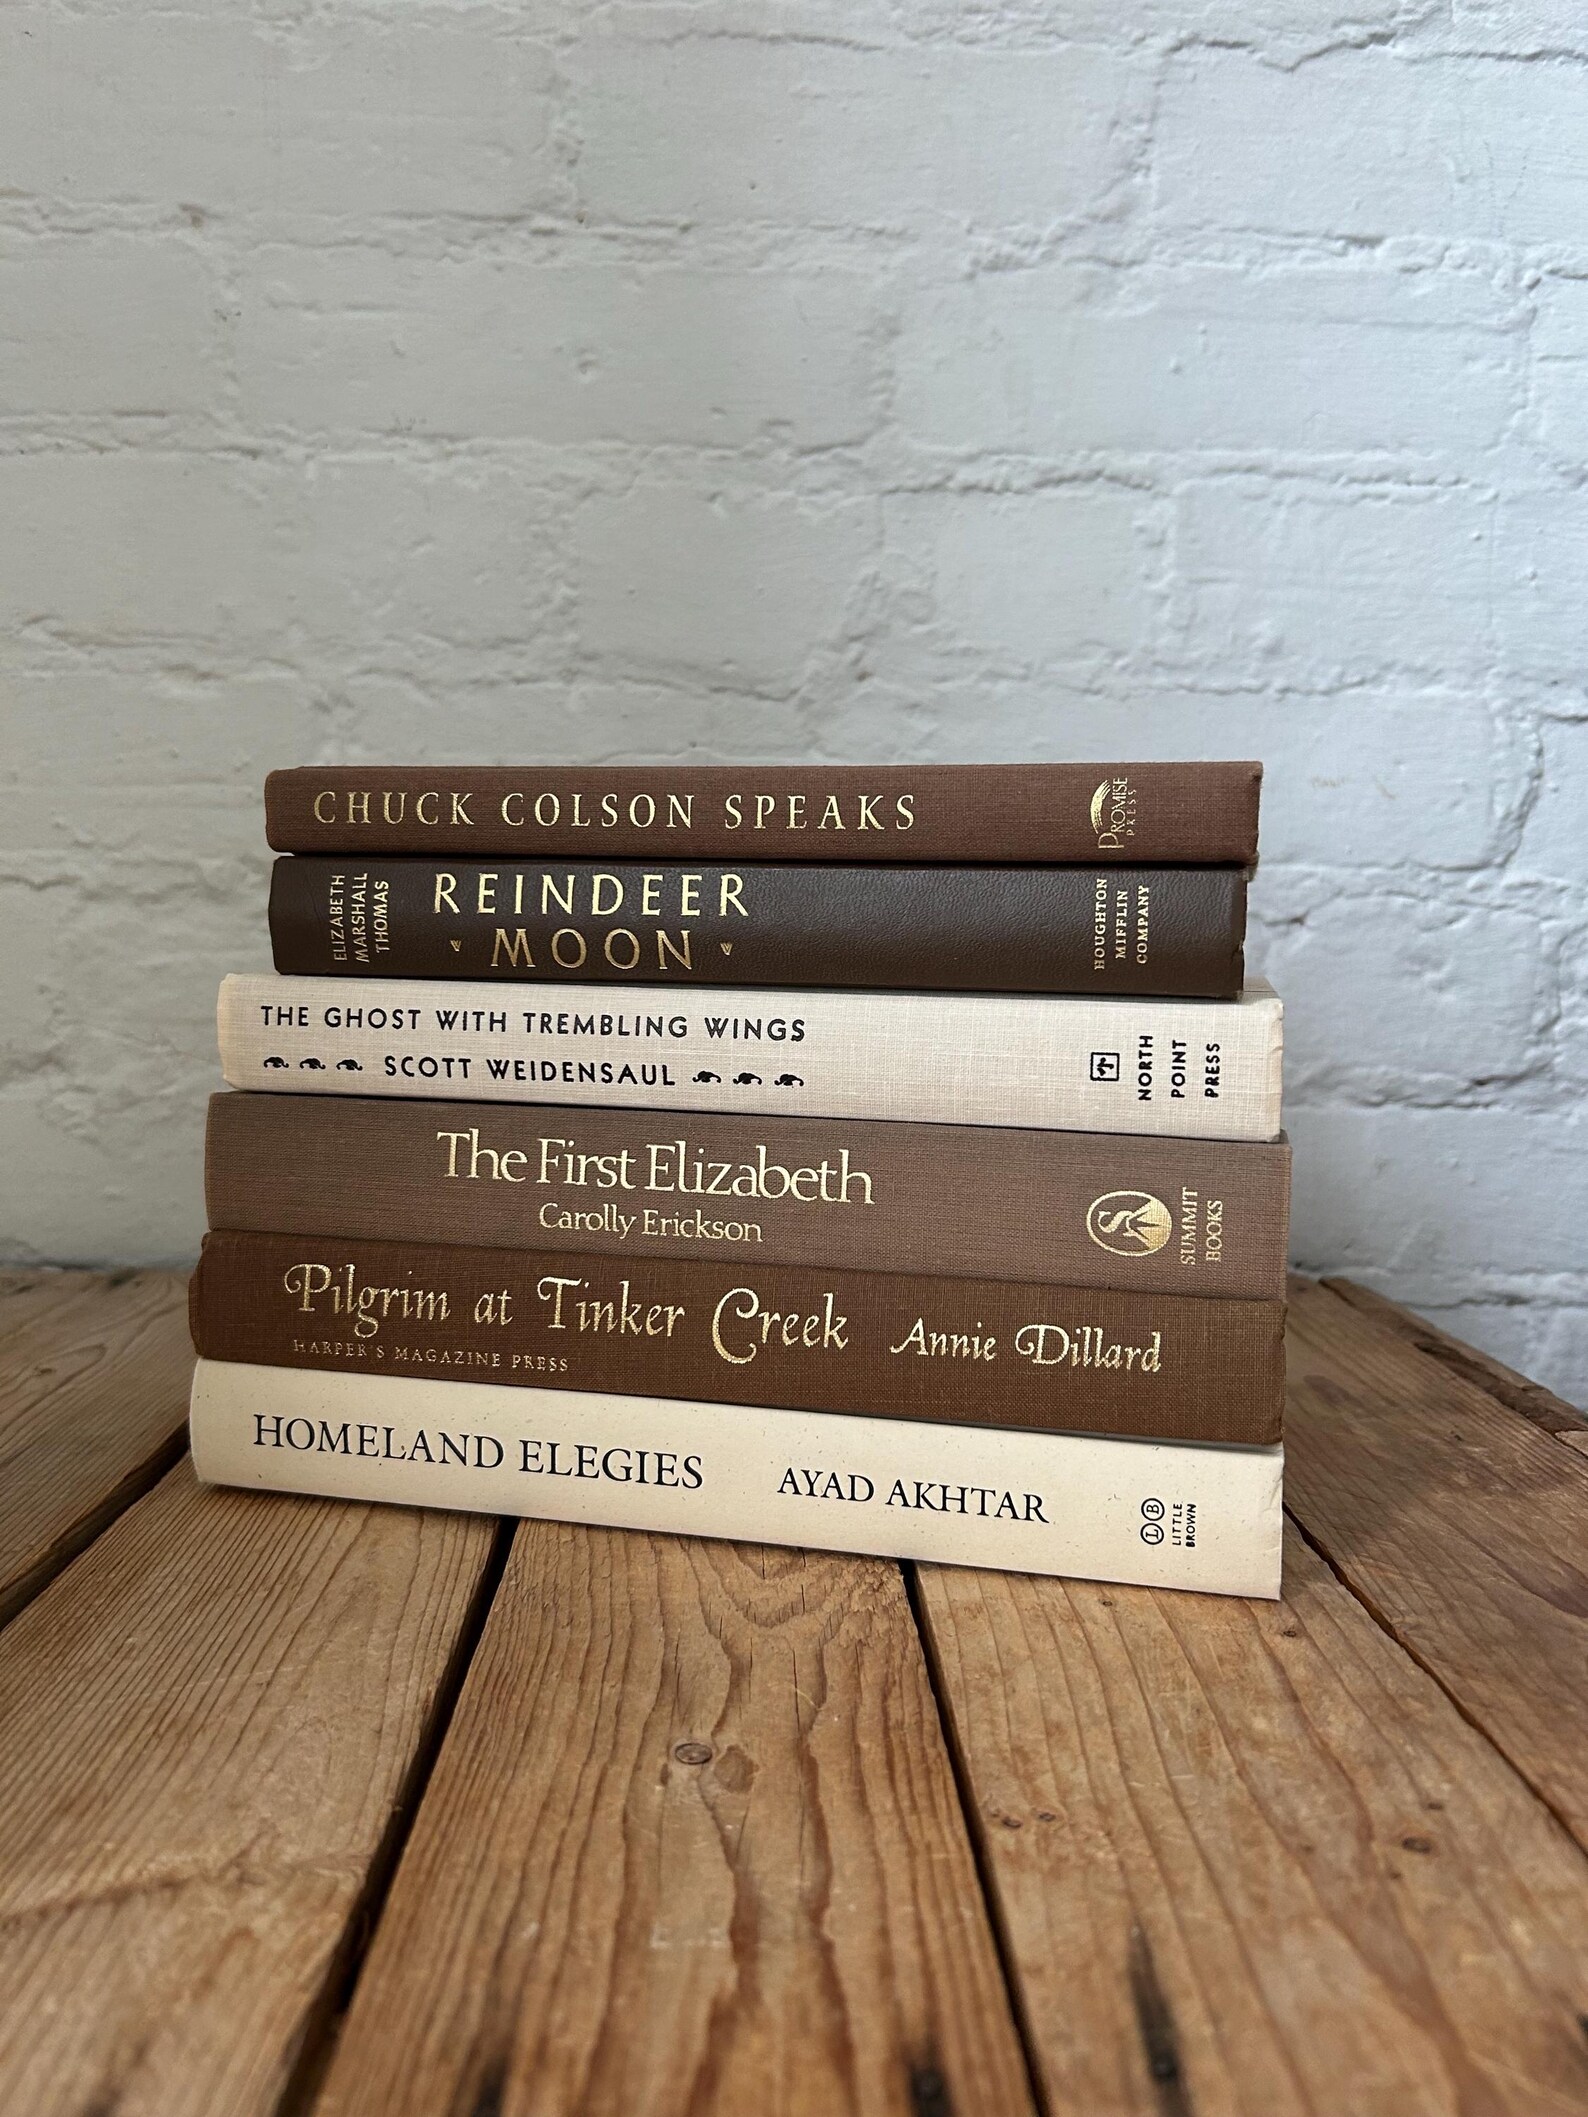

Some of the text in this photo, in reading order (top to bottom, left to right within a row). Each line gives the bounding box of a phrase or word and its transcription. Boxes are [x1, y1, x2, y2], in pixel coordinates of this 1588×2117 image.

[314, 791, 916, 830] CHUCK COLSON SPEAKS
[1126, 788, 1137, 837] PRESS
[330, 874, 348, 962] ELIZABETH
[351, 872, 368, 963] MARSHALL
[375, 880, 390, 953] THOMAS
[432, 873, 749, 917] REINDEER
[1094, 878, 1107, 970] HOUGHTON
[489, 928, 694, 970] MOON
[1116, 890, 1128, 959] MIFFLIN
[1137, 885, 1151, 965] COMPANY
[260, 1005, 806, 1043] THE GHOST WITH TREMBLING WINGS
[384, 1056, 676, 1086] SCOTT WEIDENSAUL
[1138, 1035, 1153, 1101] NORTH
[1171, 1039, 1187, 1099] POINT
[1205, 1042, 1220, 1099] PRESS
[436, 1128, 876, 1206] The First Elizabeth
[538, 1203, 764, 1244] Carolly Erickson
[1181, 1187, 1199, 1265] SUMMIT
[1205, 1200, 1224, 1263] BOOKS
[283, 1263, 849, 1364] Pilgrim at Tinker Creek
[395, 1347, 501, 1368] MAGAZINE
[512, 1355, 570, 1372] PRESS
[889, 1317, 1162, 1374] Annie Dillard
[253, 1414, 704, 1490] HOMELAND ELEGIES
[777, 1467, 1050, 1524] AYAD AKHTAR
[1172, 1503, 1183, 1546] LITTLE
[1185, 1503, 1197, 1548] BROWN
